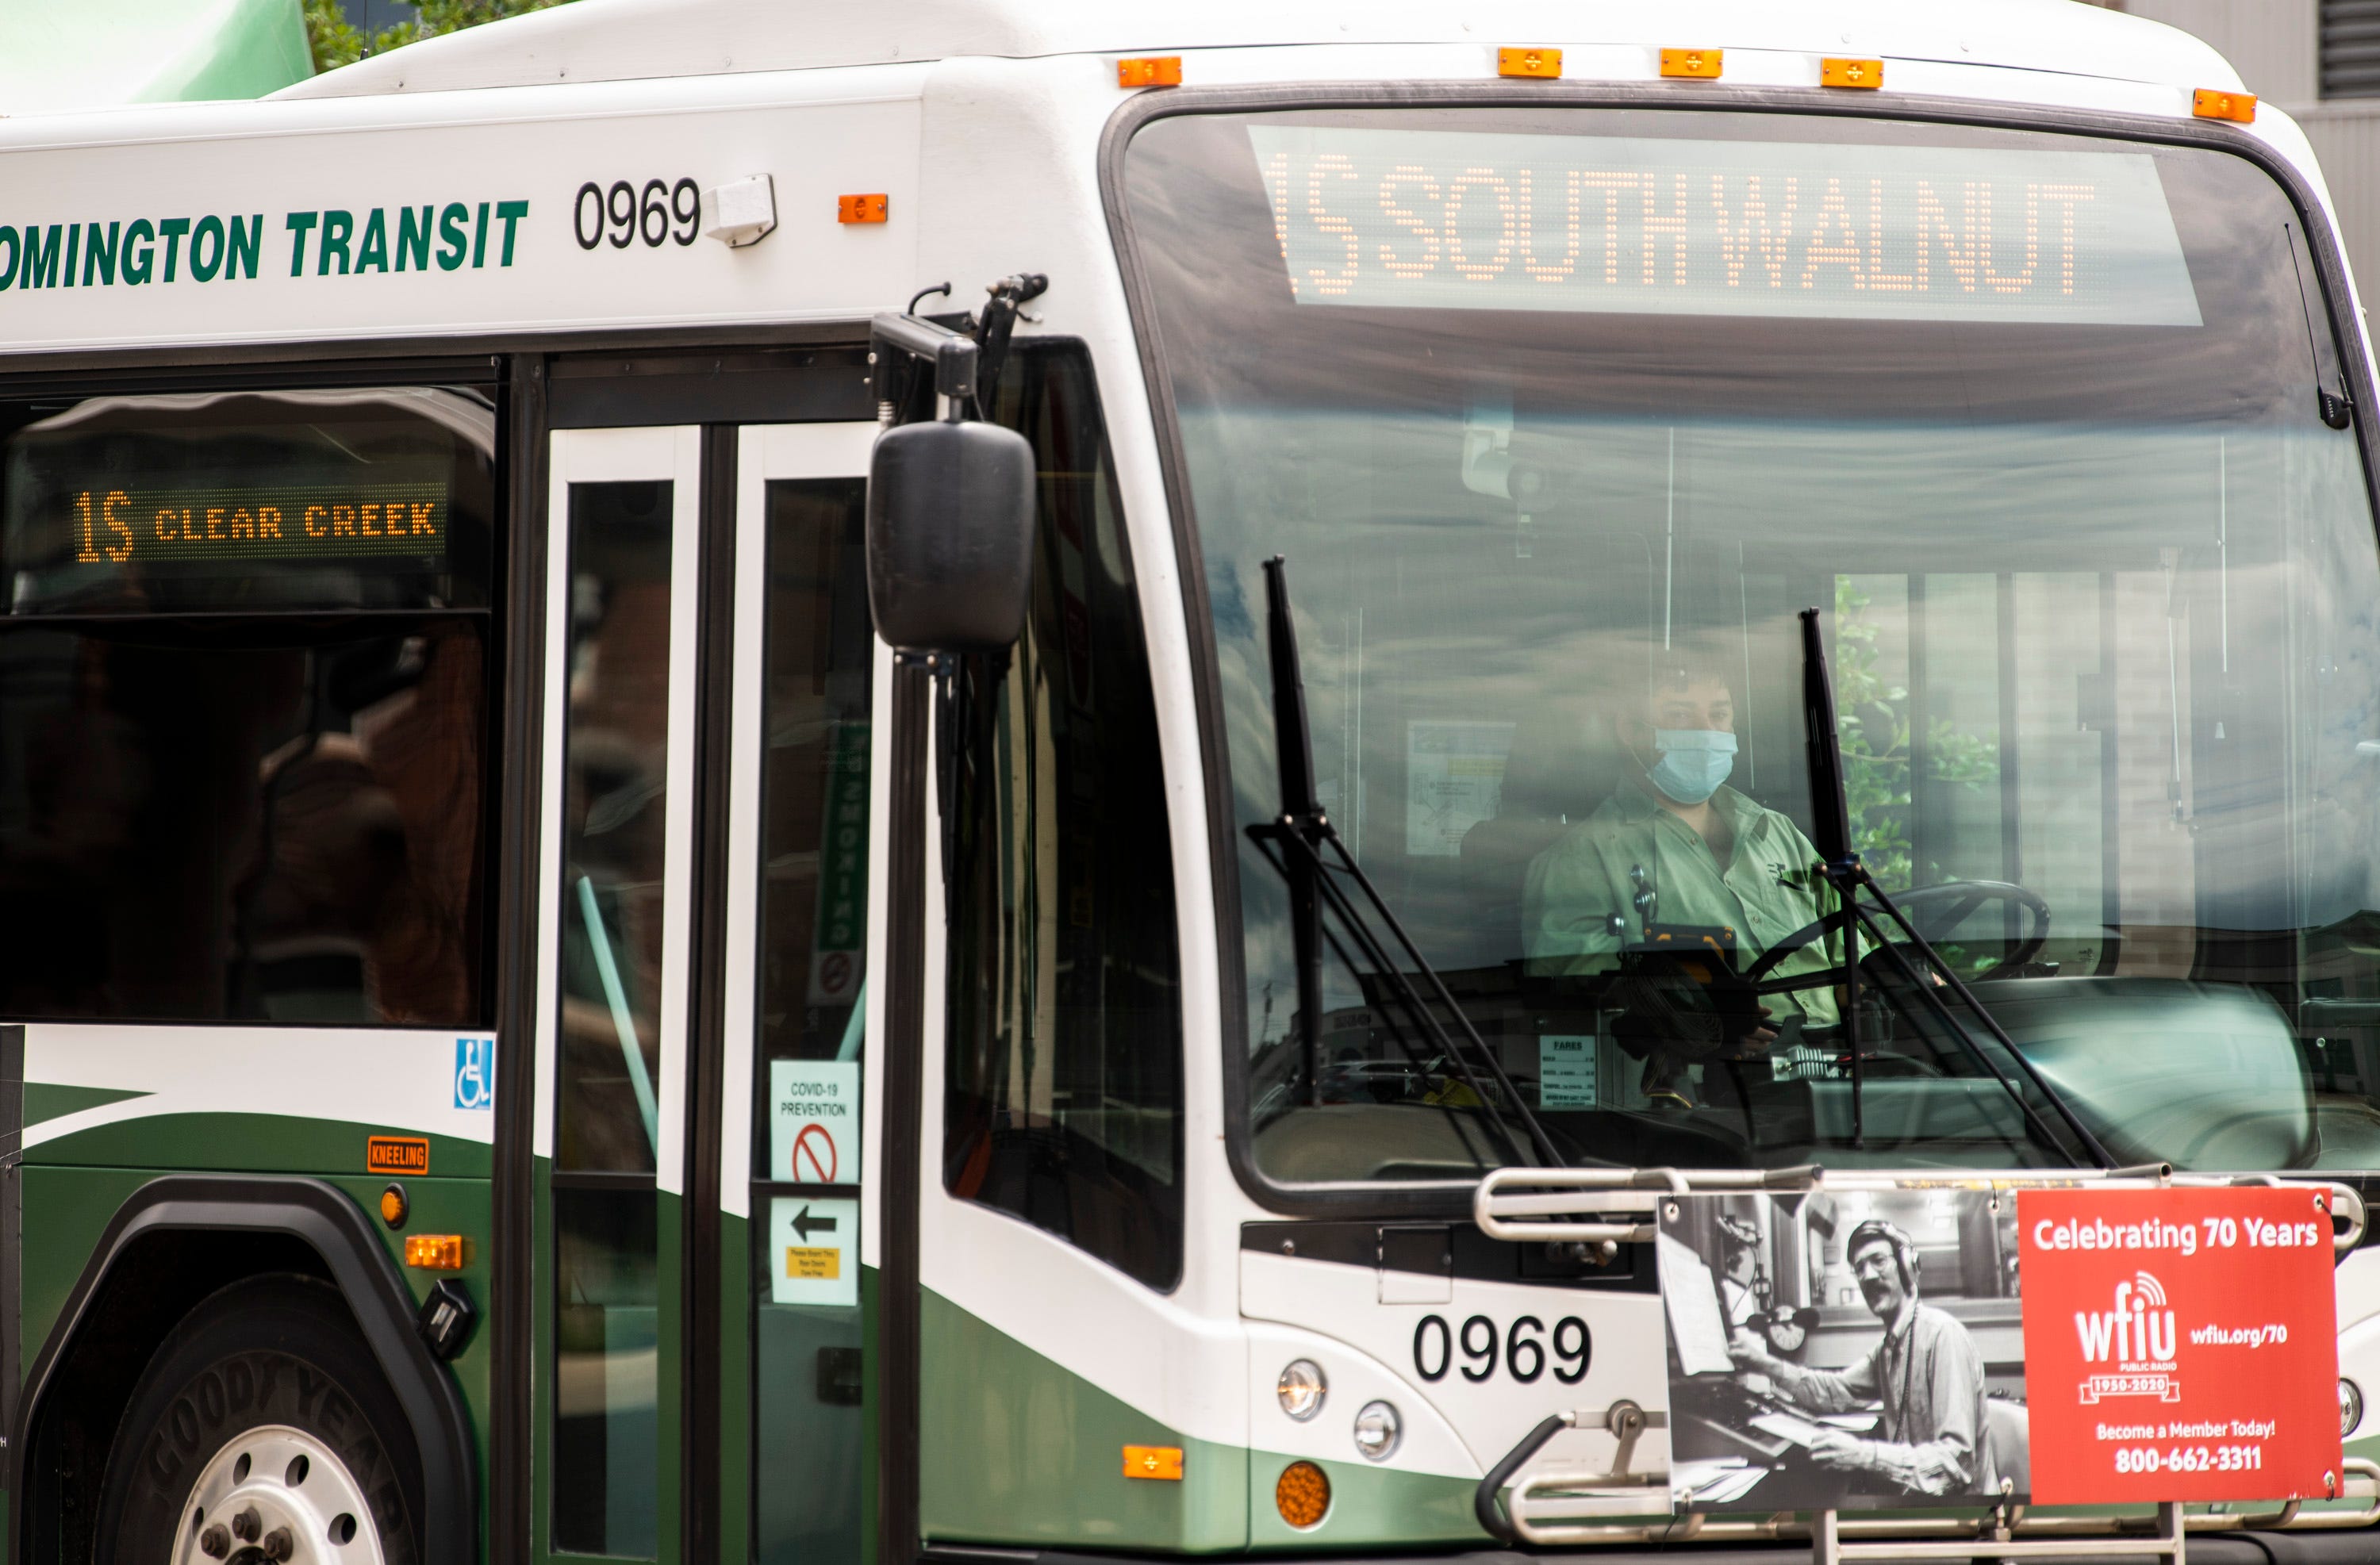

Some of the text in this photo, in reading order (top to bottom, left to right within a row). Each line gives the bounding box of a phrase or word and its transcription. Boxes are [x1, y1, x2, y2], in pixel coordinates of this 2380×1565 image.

[574, 177, 701, 251] 0969
[1380, 165, 1686, 286] SOUTH
[1712, 174, 2095, 294] WALNUT
[0, 200, 528, 292] OMINGTON TRANSIT
[77, 490, 436, 563] 1S CLEAR CREEK
[1554, 1041, 1583, 1051] FARES
[790, 1082, 838, 1096] COVID-19
[781, 1102, 846, 1117] PREVENTION
[372, 1145, 424, 1166] KNEELING
[2033, 1217, 2319, 1256] Celebrating 70 Years
[2075, 1279, 2176, 1362] wfiu
[1413, 1314, 1592, 1384] 0969
[2190, 1324, 2288, 1348] wfiu.org/70
[2119, 1362, 2177, 1371] PUBLIC RADIO
[2094, 1378, 2166, 1392] 1950-2020
[2096, 1419, 2276, 1440] Become a Member Today!
[2115, 1445, 2262, 1473] 800-662-3311
